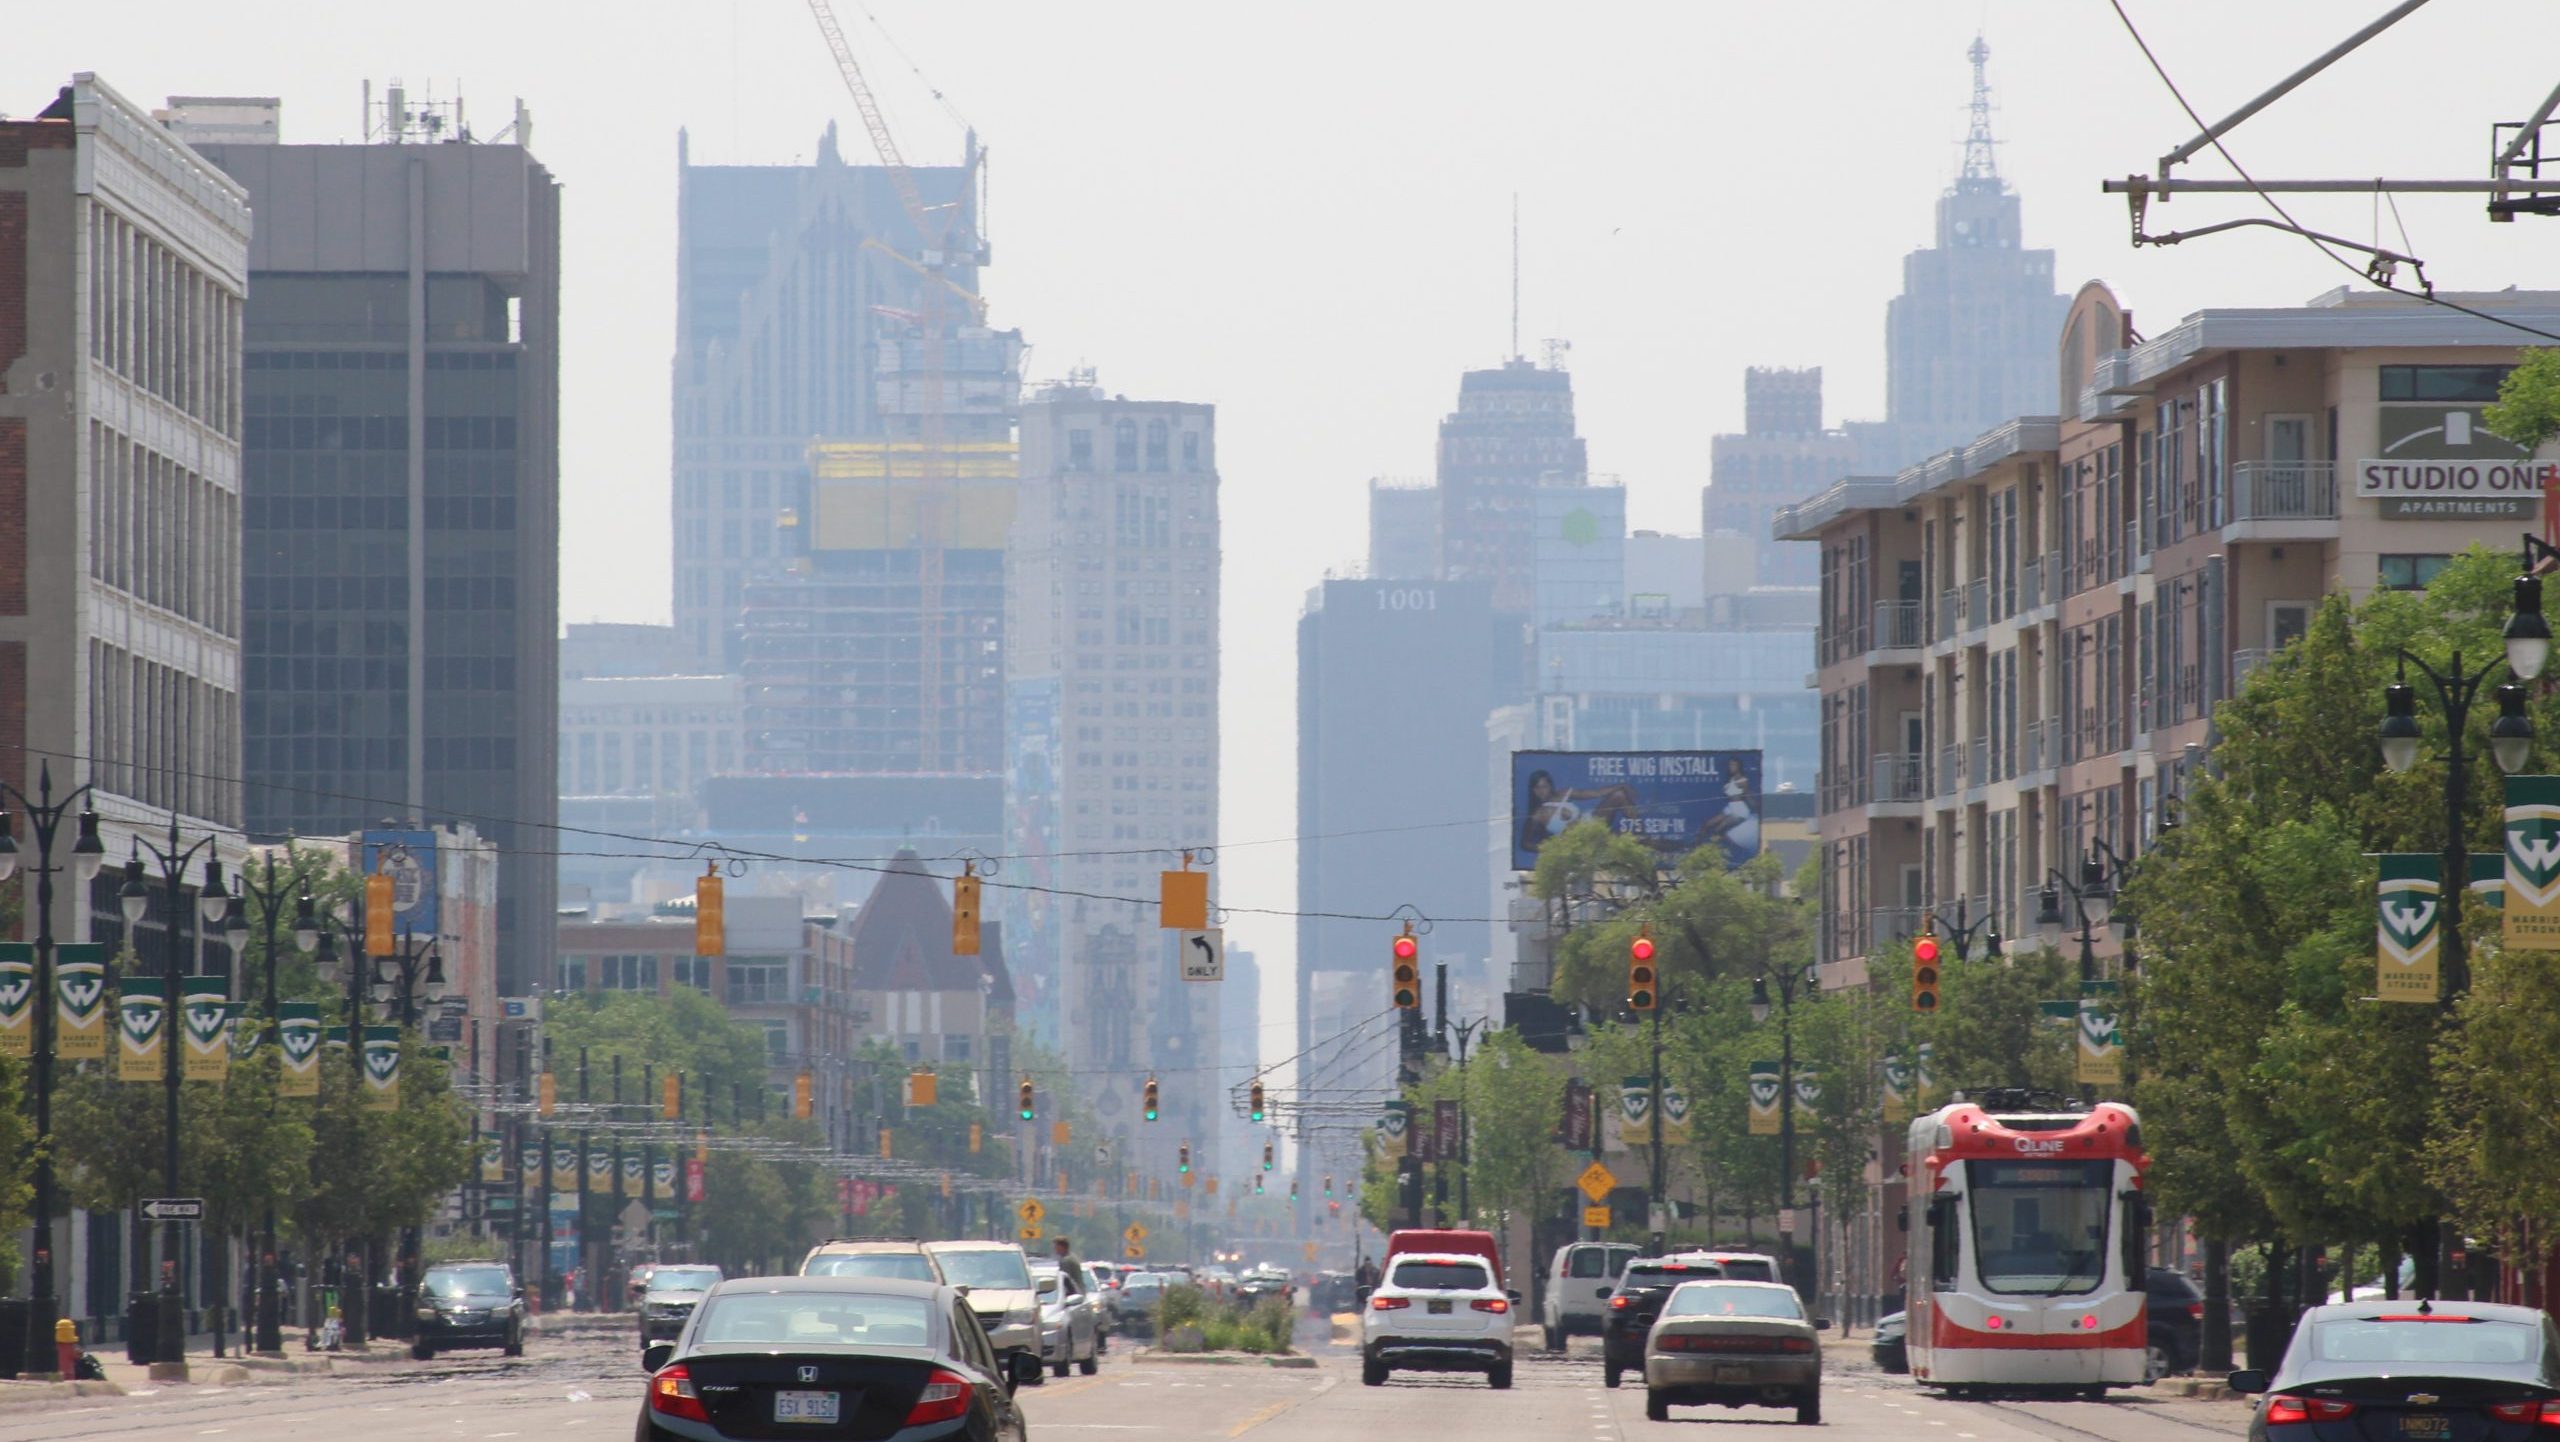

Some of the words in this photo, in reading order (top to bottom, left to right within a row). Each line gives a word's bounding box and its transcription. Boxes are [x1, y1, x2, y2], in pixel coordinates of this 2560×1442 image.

[2365, 465, 2479, 490] STUDIO
[2488, 465, 2549, 490] ONE
[2399, 502, 2518, 513] APARTMENTS
[1376, 588, 1437, 610] 1001
[1588, 757, 1625, 776] FREE
[1628, 757, 1657, 776] WIG
[1660, 757, 1719, 776] INSTALL
[2512, 915, 2560, 924] WARRIO
[2515, 925, 2560, 934] STRON
[1187, 966, 1218, 976] ONLY
[2014, 1137, 2064, 1152] QLINE
